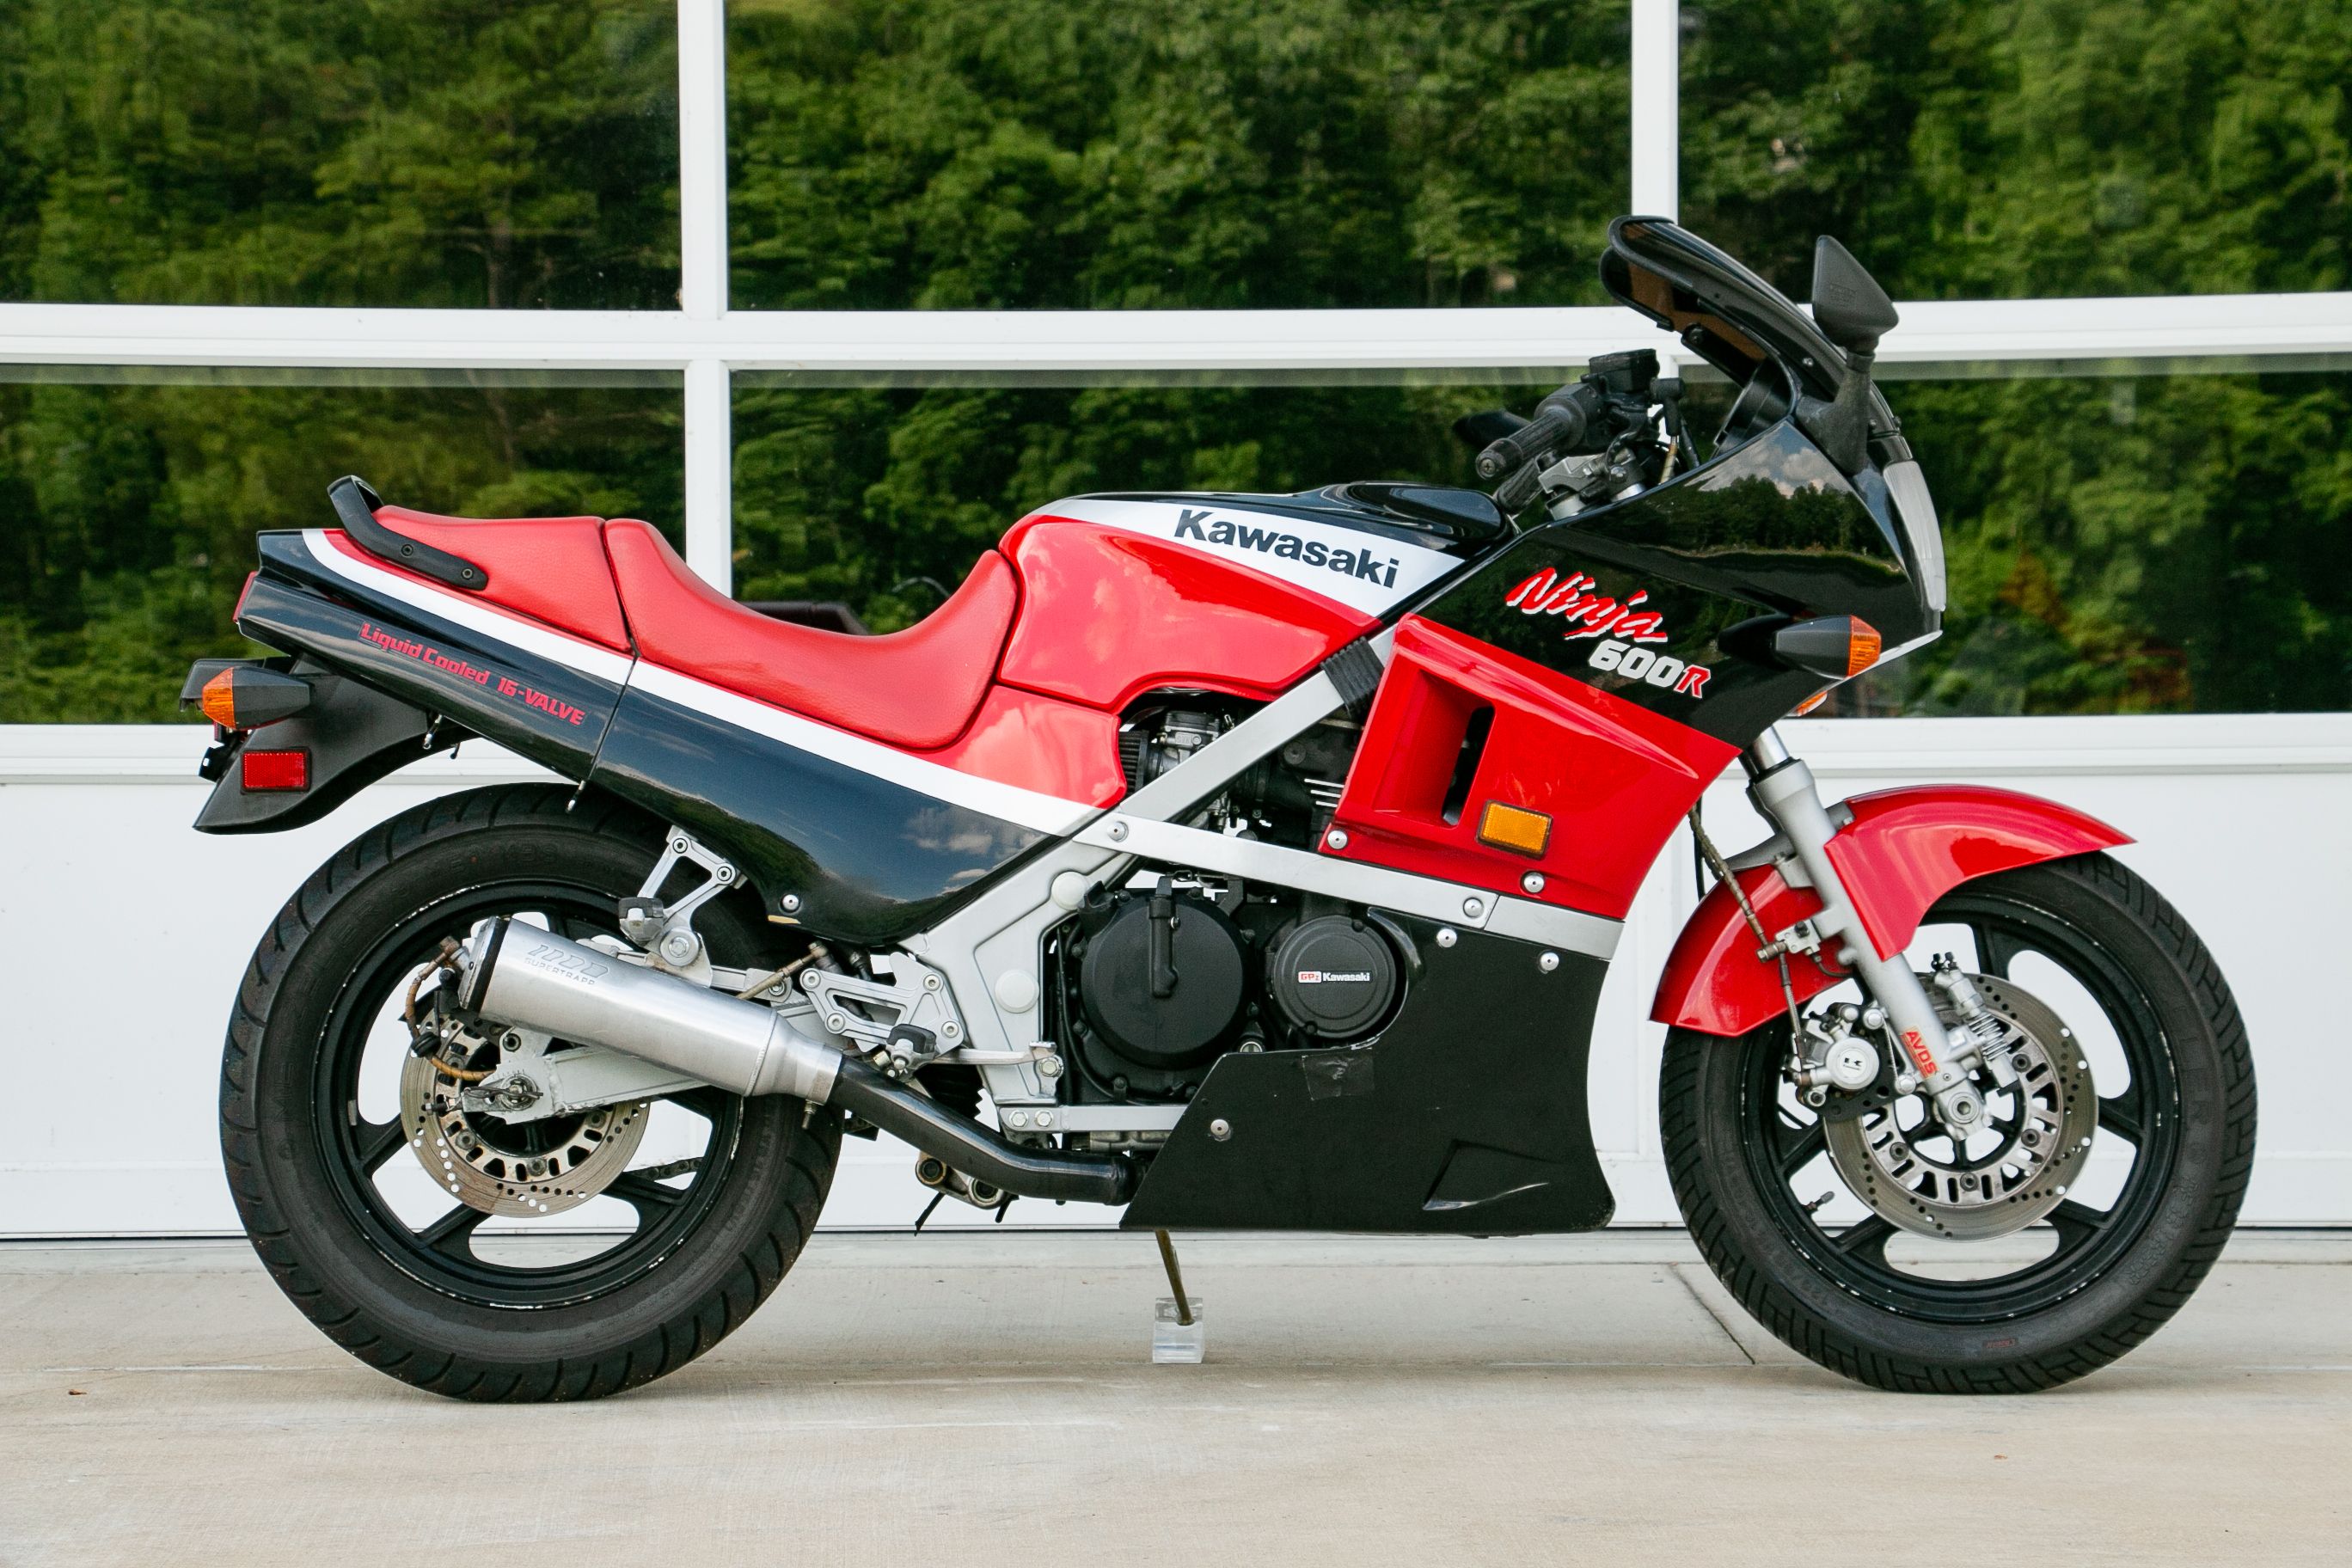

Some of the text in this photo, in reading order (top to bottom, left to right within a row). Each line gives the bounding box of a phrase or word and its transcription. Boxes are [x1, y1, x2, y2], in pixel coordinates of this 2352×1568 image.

[1174, 509, 1400, 589] Kawasaki
[1504, 567, 1669, 643] Ninja
[359, 622, 586, 726] Liquid Cooled 16-VALVE
[1588, 639, 1712, 699] 600R
[524, 957, 596, 985] SUPERTRAPP
[1322, 972, 1370, 982] Kawasaki
[1905, 1031, 1938, 1074] AVDS
